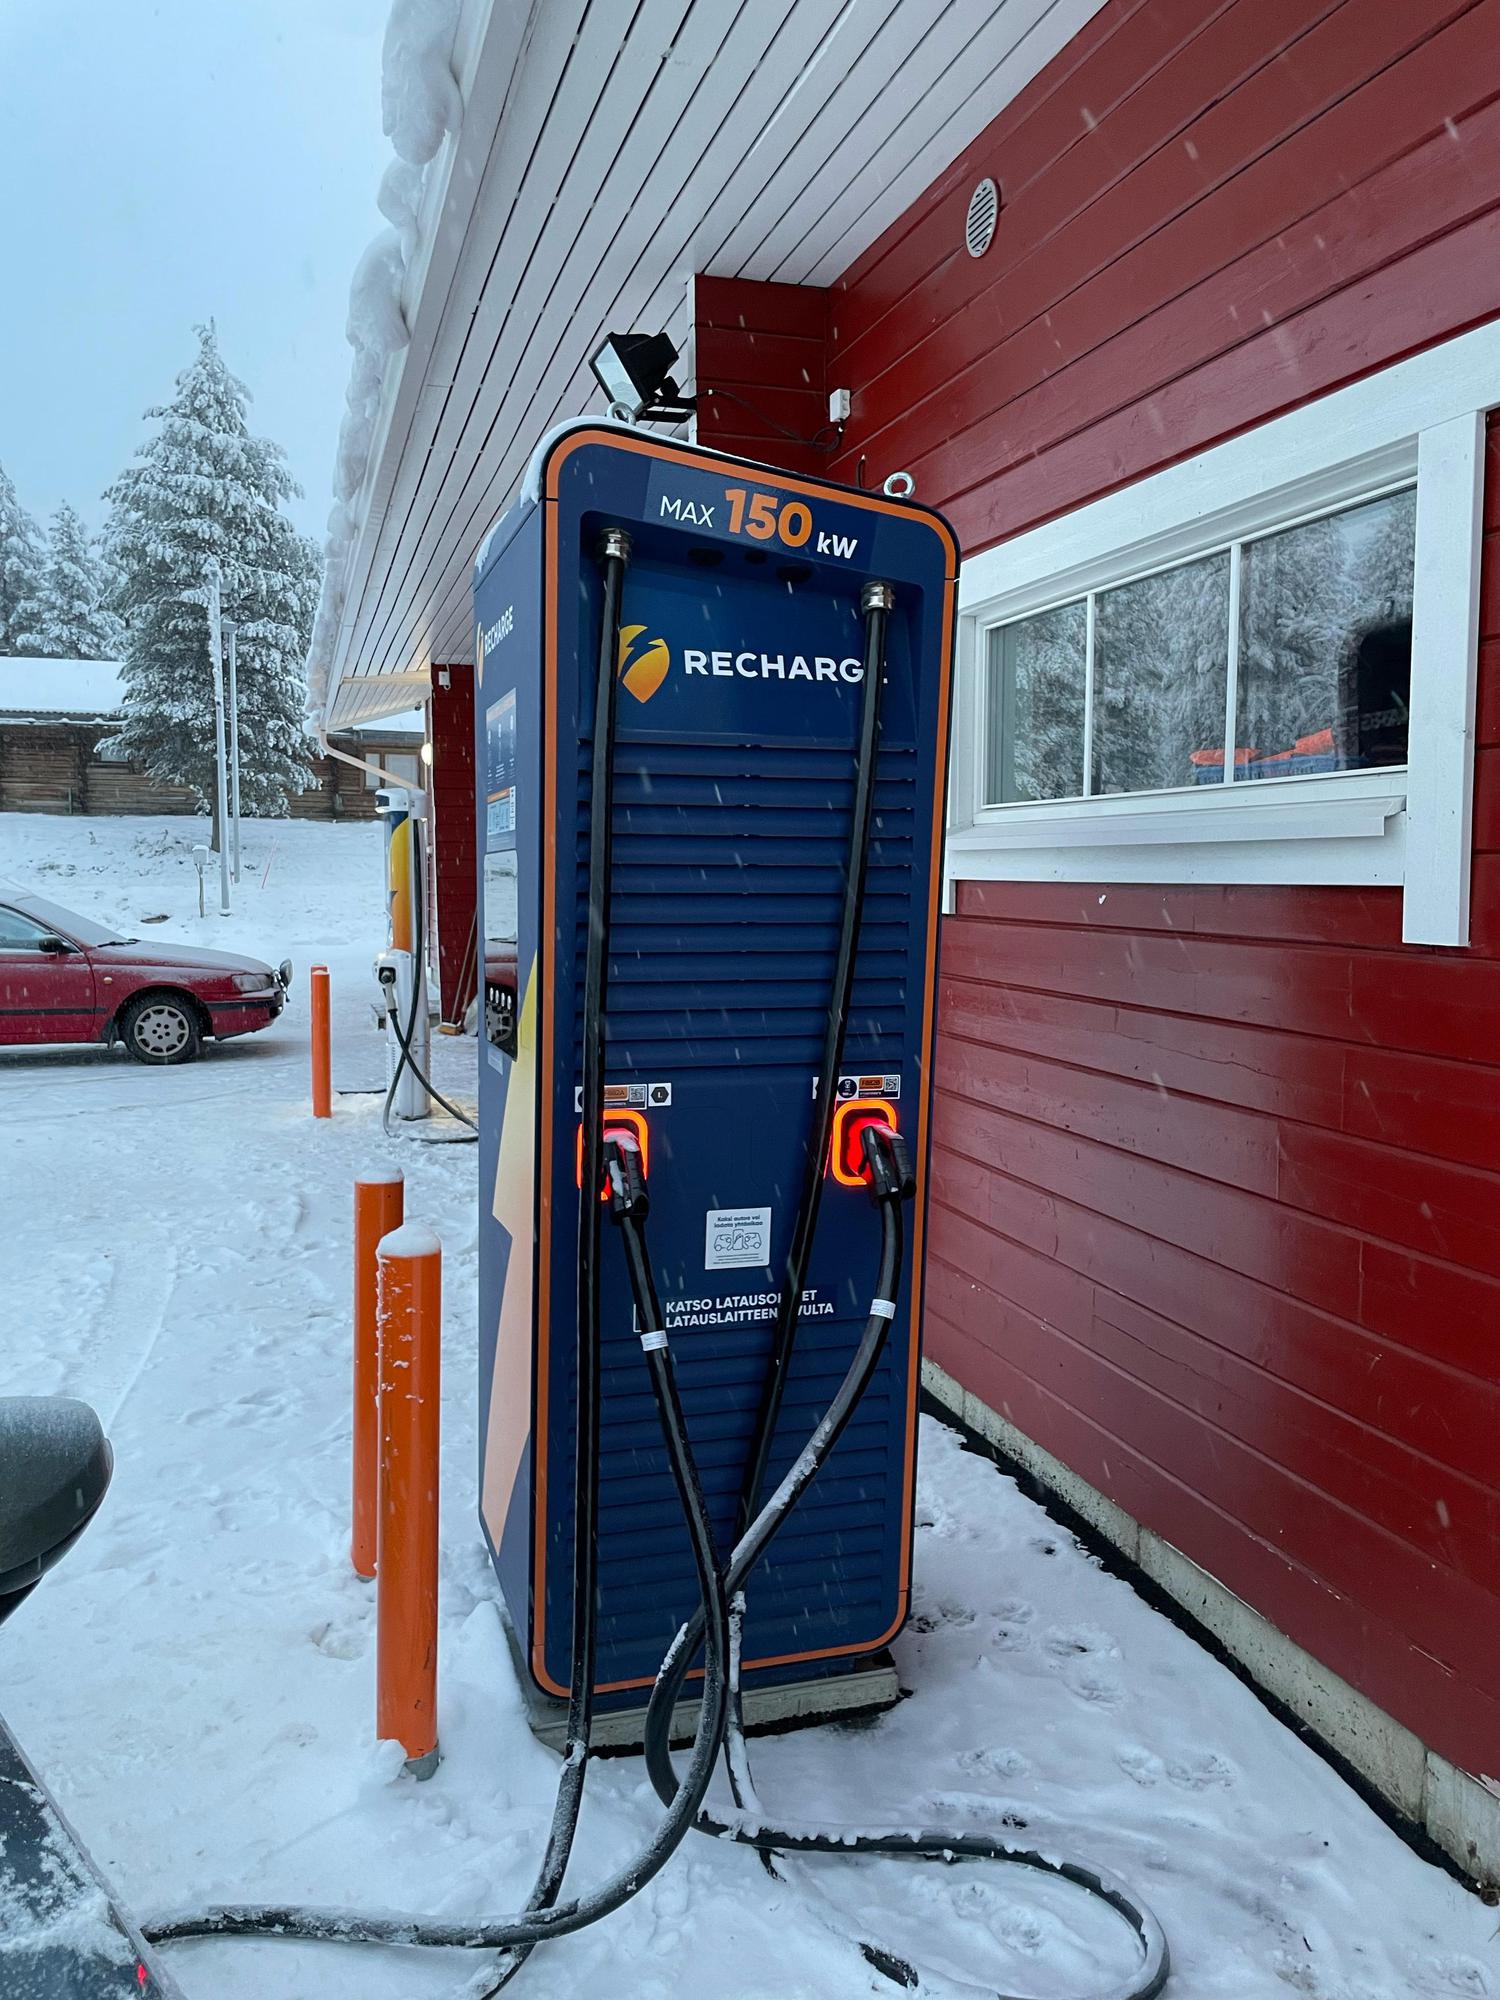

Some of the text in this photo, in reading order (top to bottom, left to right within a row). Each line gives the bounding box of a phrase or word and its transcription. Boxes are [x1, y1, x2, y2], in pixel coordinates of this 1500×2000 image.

[659, 488, 858, 560] MAX 150 kW
[484, 605, 514, 657] RECHARGE
[665, 1289, 818, 1314] KATSO LATAUSOET
[665, 1302, 834, 1328] LATAUSLAITTEEN ULTA
